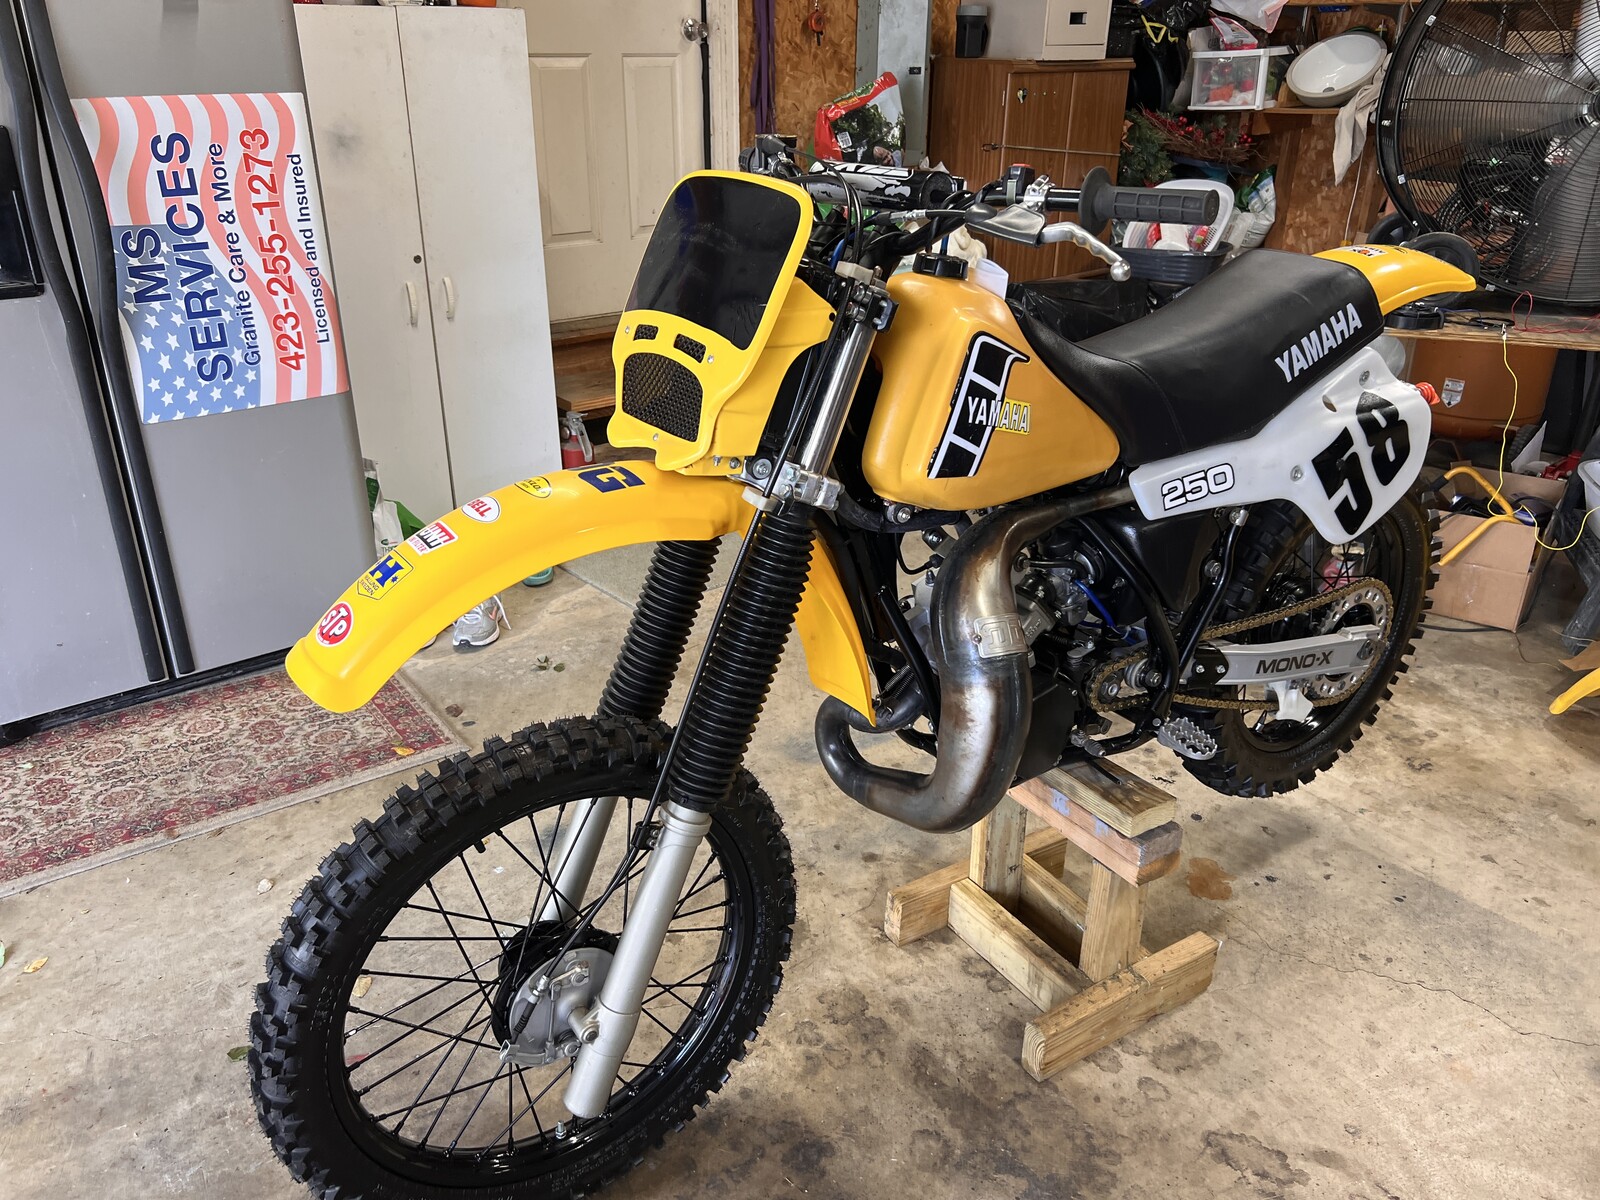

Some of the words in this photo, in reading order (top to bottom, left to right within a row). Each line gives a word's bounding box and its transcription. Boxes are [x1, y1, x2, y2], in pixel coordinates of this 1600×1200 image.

[209, 143, 232, 202] More
[287, 153, 311, 224] Insured
[218, 208, 236, 225] &
[239, 128, 301, 371] 423-255-1273
[298, 228, 318, 261] and
[121, 227, 172, 303] MS
[150, 131, 233, 382] SERVICES
[226, 231, 247, 283] Care
[236, 289, 261, 366] Granite
[305, 266, 330, 344] Licensed
[1274, 302, 1363, 383] YAMAHA
[967, 395, 1030, 434] YAMAHA
[1161, 462, 1235, 511] 250
[1311, 391, 1411, 536] 58
[321, 606, 349, 638] STP
